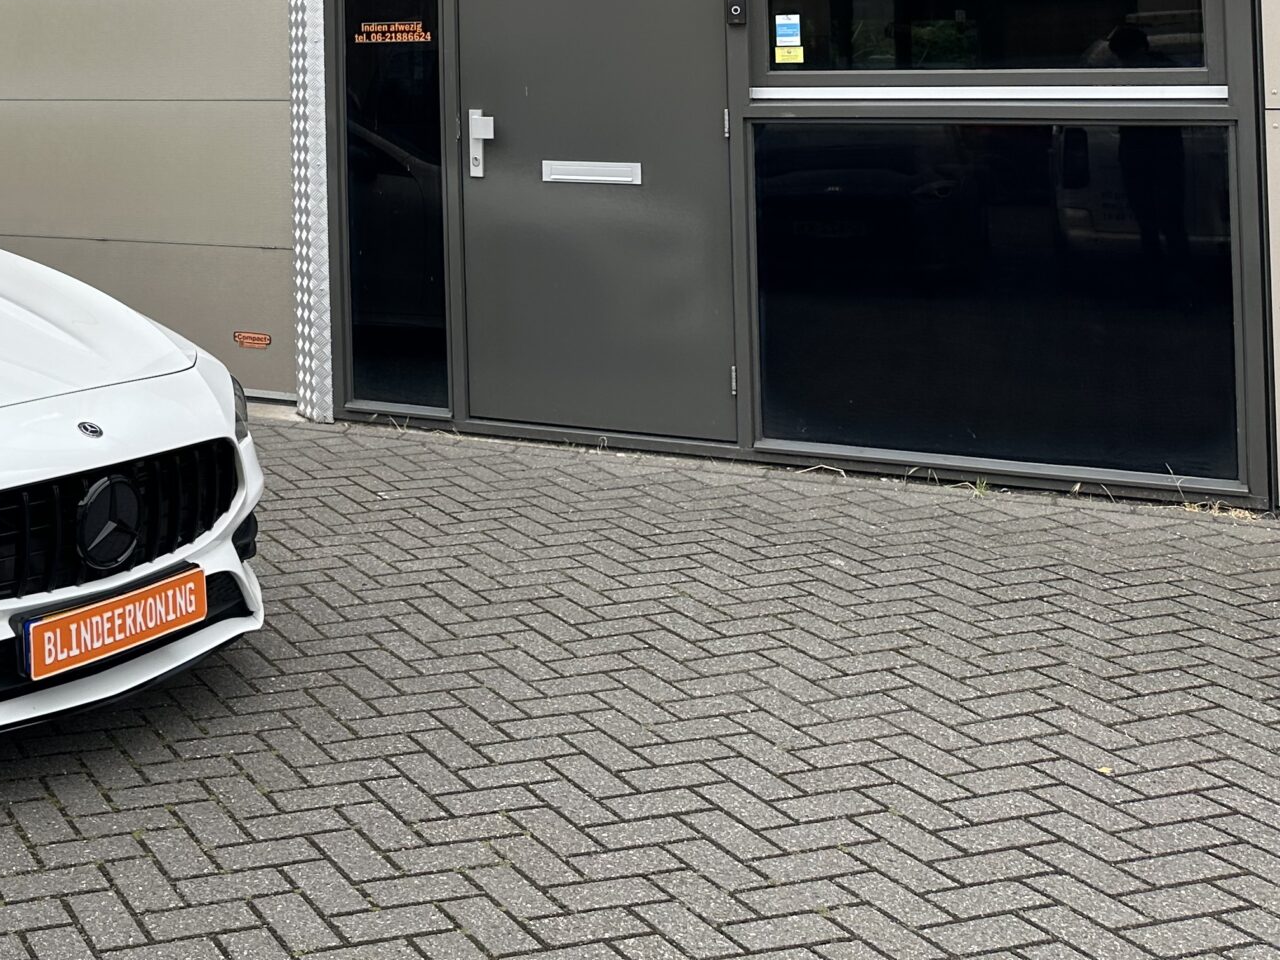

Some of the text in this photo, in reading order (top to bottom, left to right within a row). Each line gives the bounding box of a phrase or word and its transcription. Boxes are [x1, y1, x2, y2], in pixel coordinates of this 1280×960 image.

[361, 22, 422, 33] Indien afwezig
[354, 32, 431, 42] tel. 06-21886624
[43, 581, 196, 665] BLINDEERKONING
